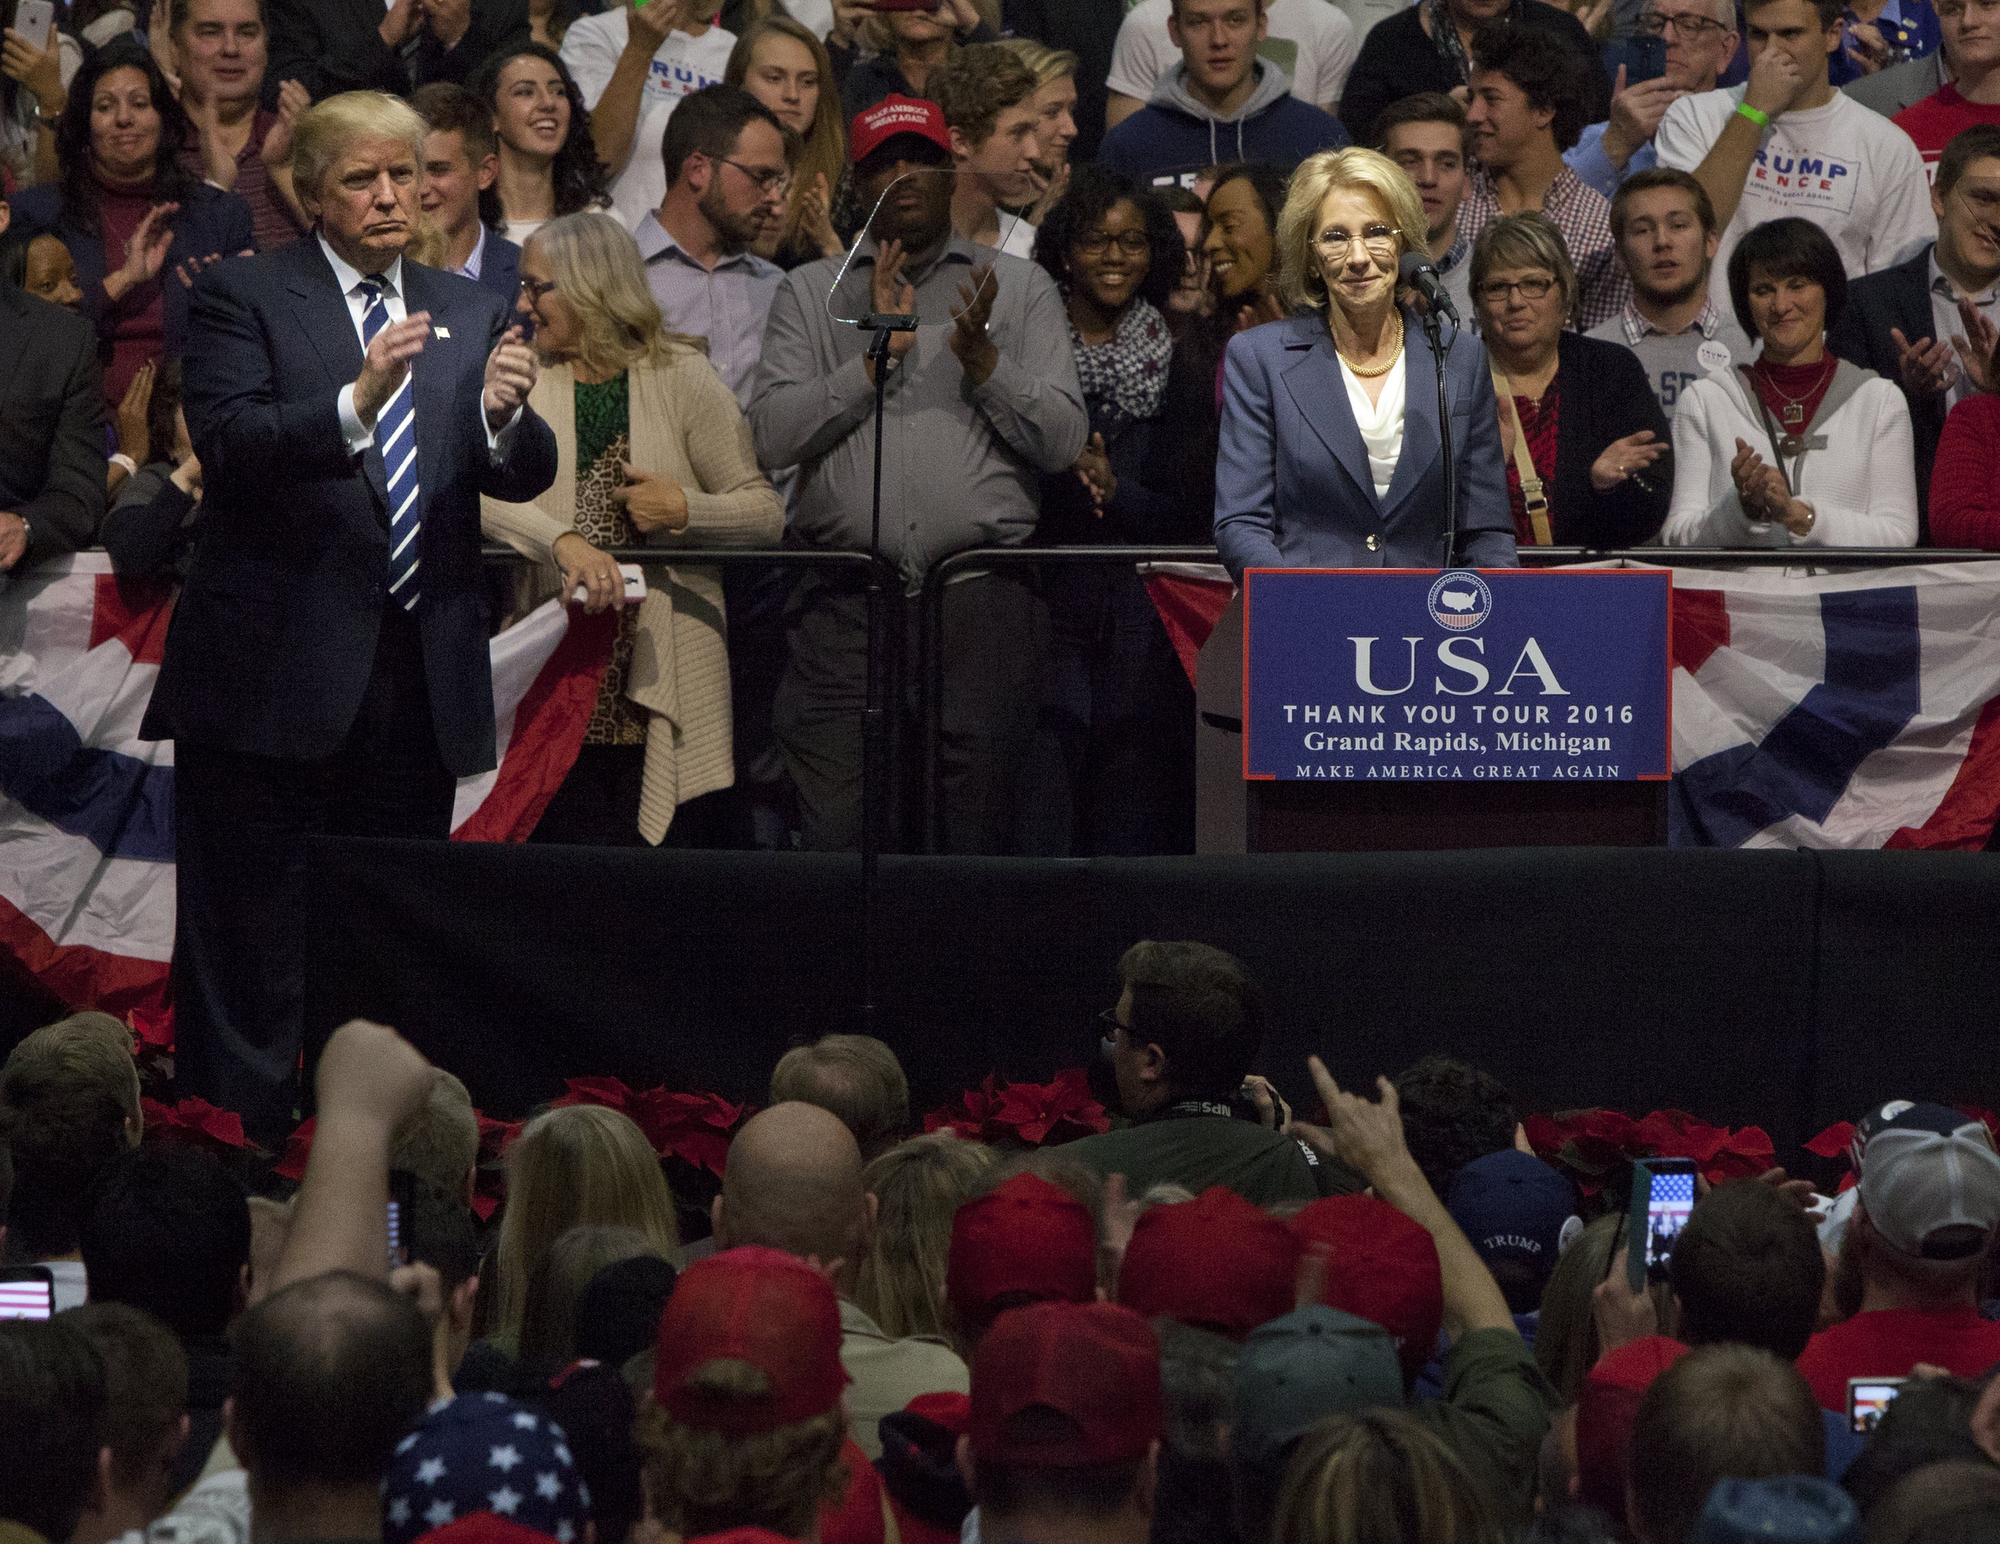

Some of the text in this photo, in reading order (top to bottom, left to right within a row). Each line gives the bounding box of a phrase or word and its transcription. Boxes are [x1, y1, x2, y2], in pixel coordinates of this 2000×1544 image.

[1754, 149, 1848, 179] RUMP
[1755, 167, 1832, 191] ENCE
[1347, 636, 1571, 695] USA
[1283, 705, 1633, 723] THANK YOU TOUR 2016
[1303, 732, 1611, 756] Grand Rapids, Michigan
[1296, 765, 1619, 778] MAKE AMERICA GREAT AGAIN
[1483, 1232, 1542, 1254] TRUMP
